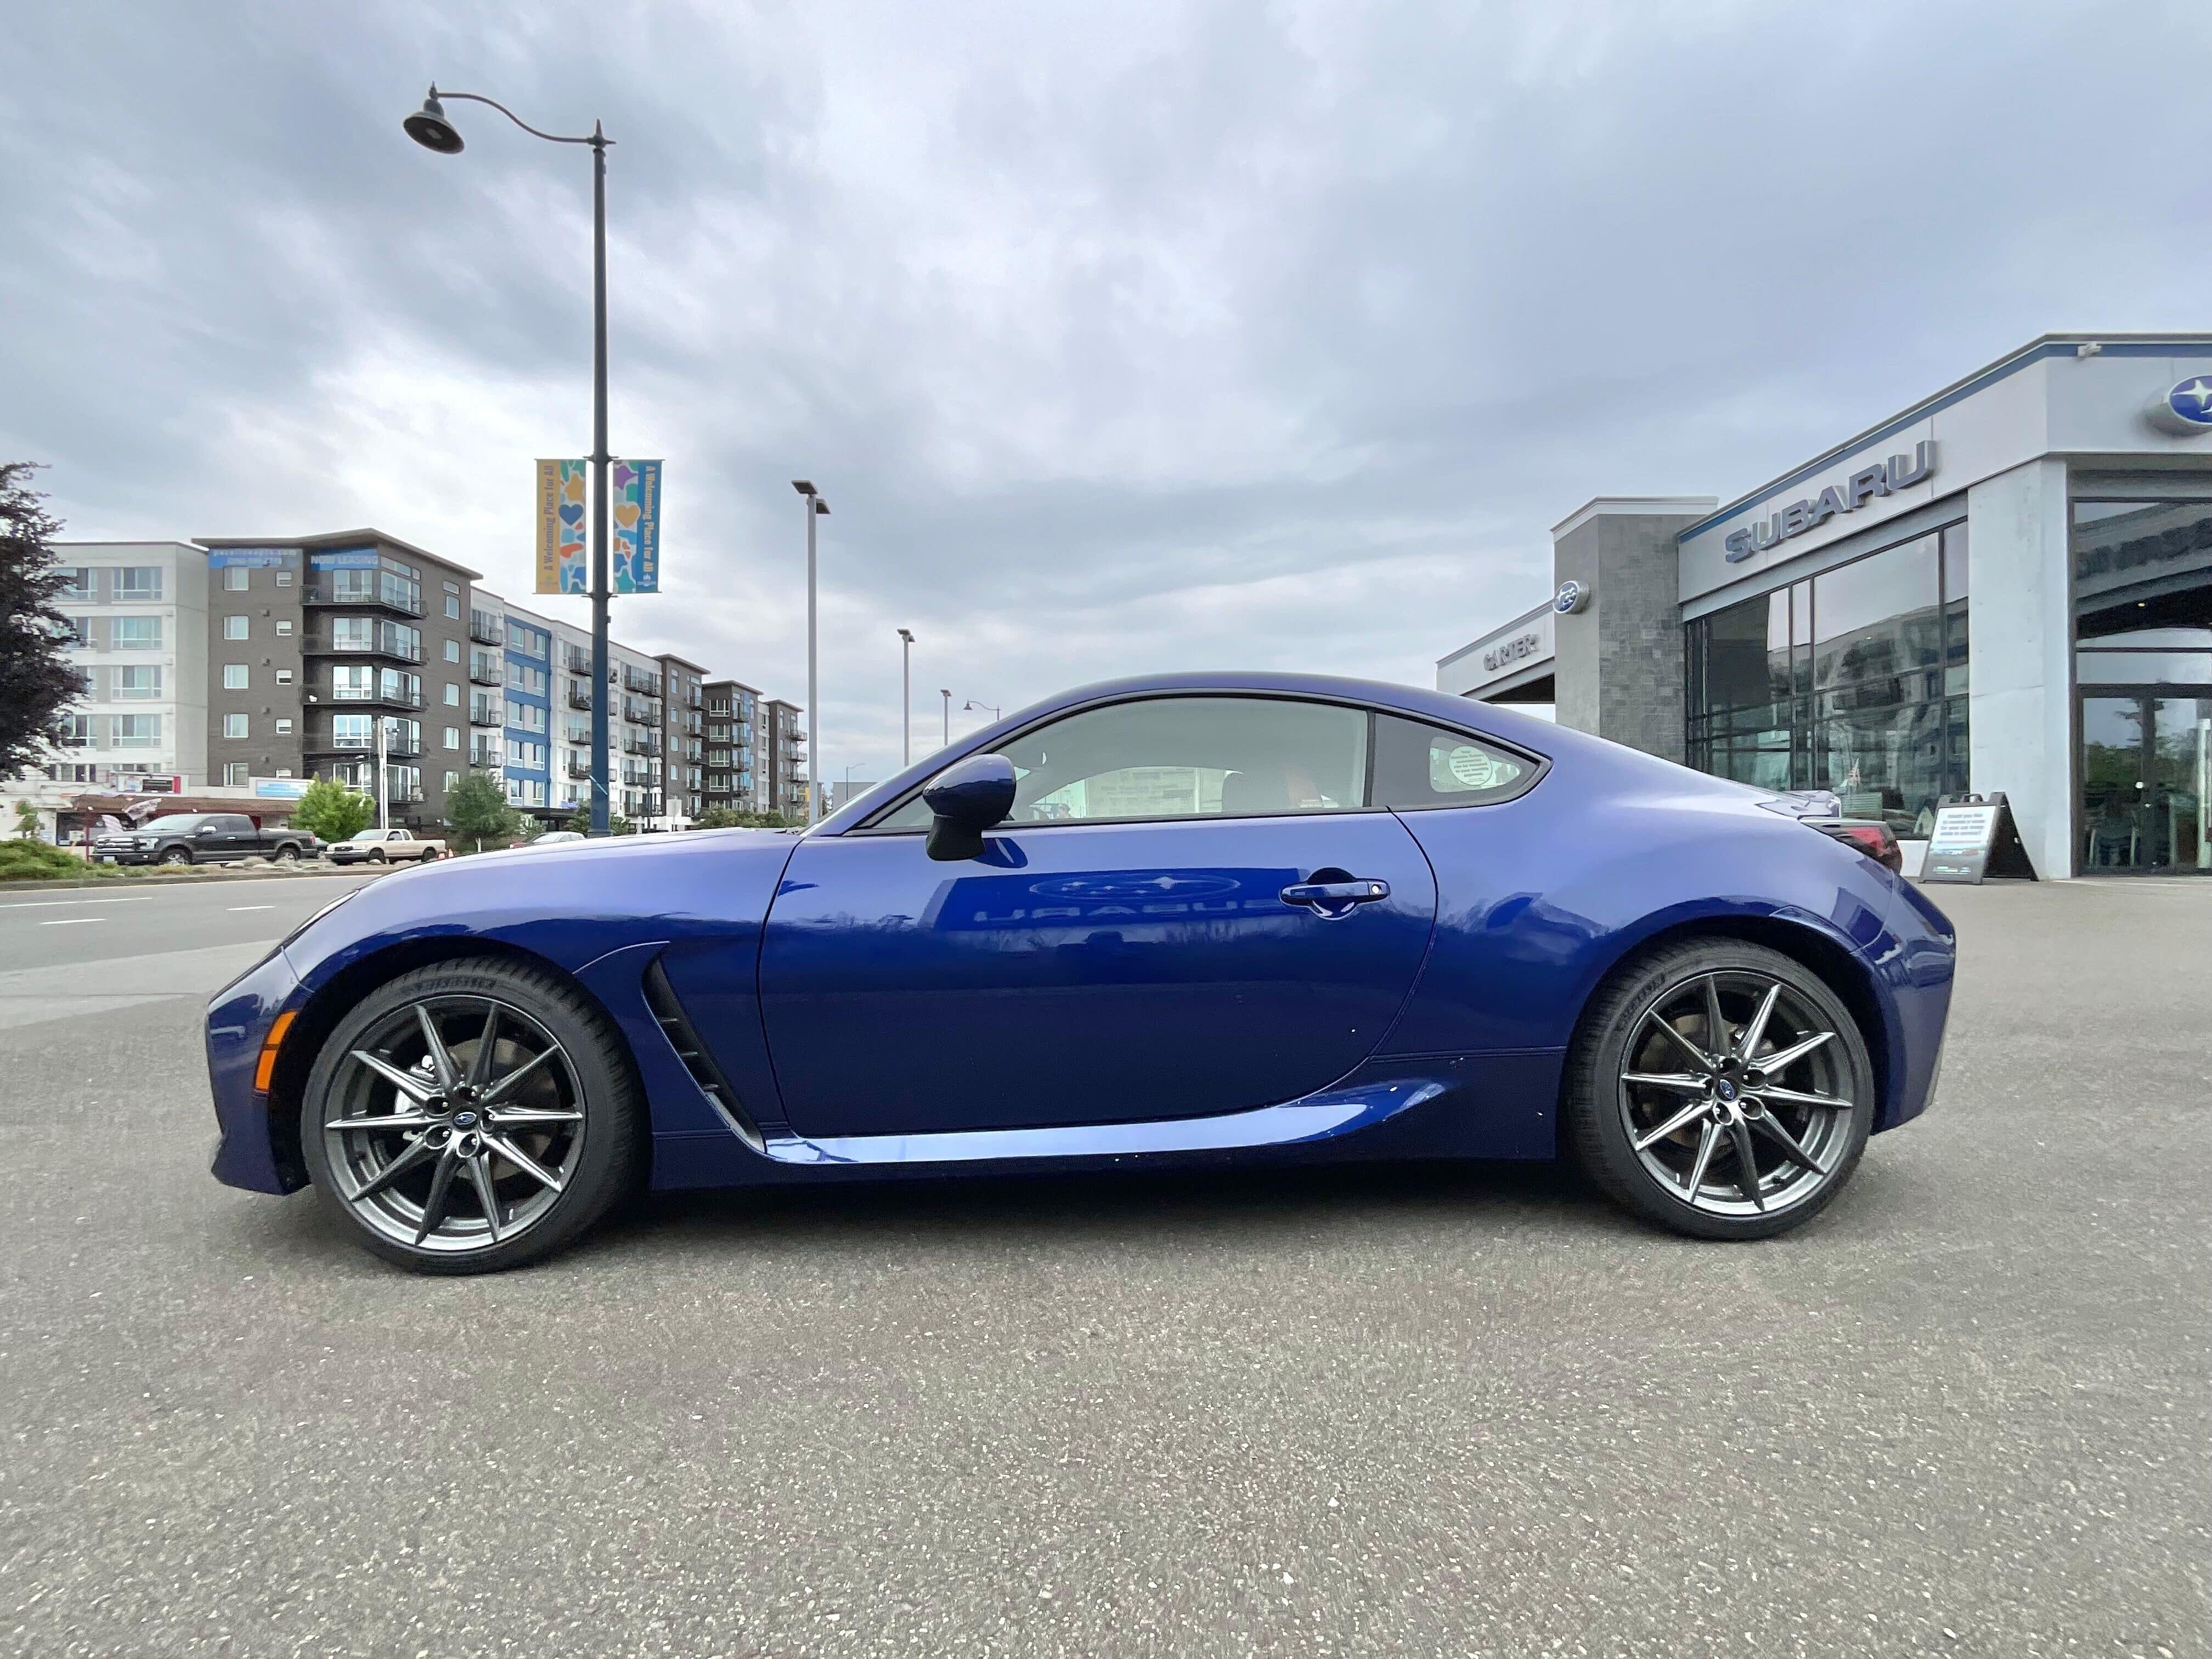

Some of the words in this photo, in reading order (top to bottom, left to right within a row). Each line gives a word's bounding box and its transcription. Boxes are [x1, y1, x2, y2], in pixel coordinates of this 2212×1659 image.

[544, 465, 554, 476] All
[544, 478, 554, 489] for
[544, 492, 554, 515] Place
[642, 473, 656, 520] Welcoming
[1725, 440, 1936, 563] SUBARU
[543, 517, 555, 563] Welcoming
[644, 522, 654, 545] Place
[643, 561, 654, 572] All
[1483, 634, 1534, 672] CARTER
